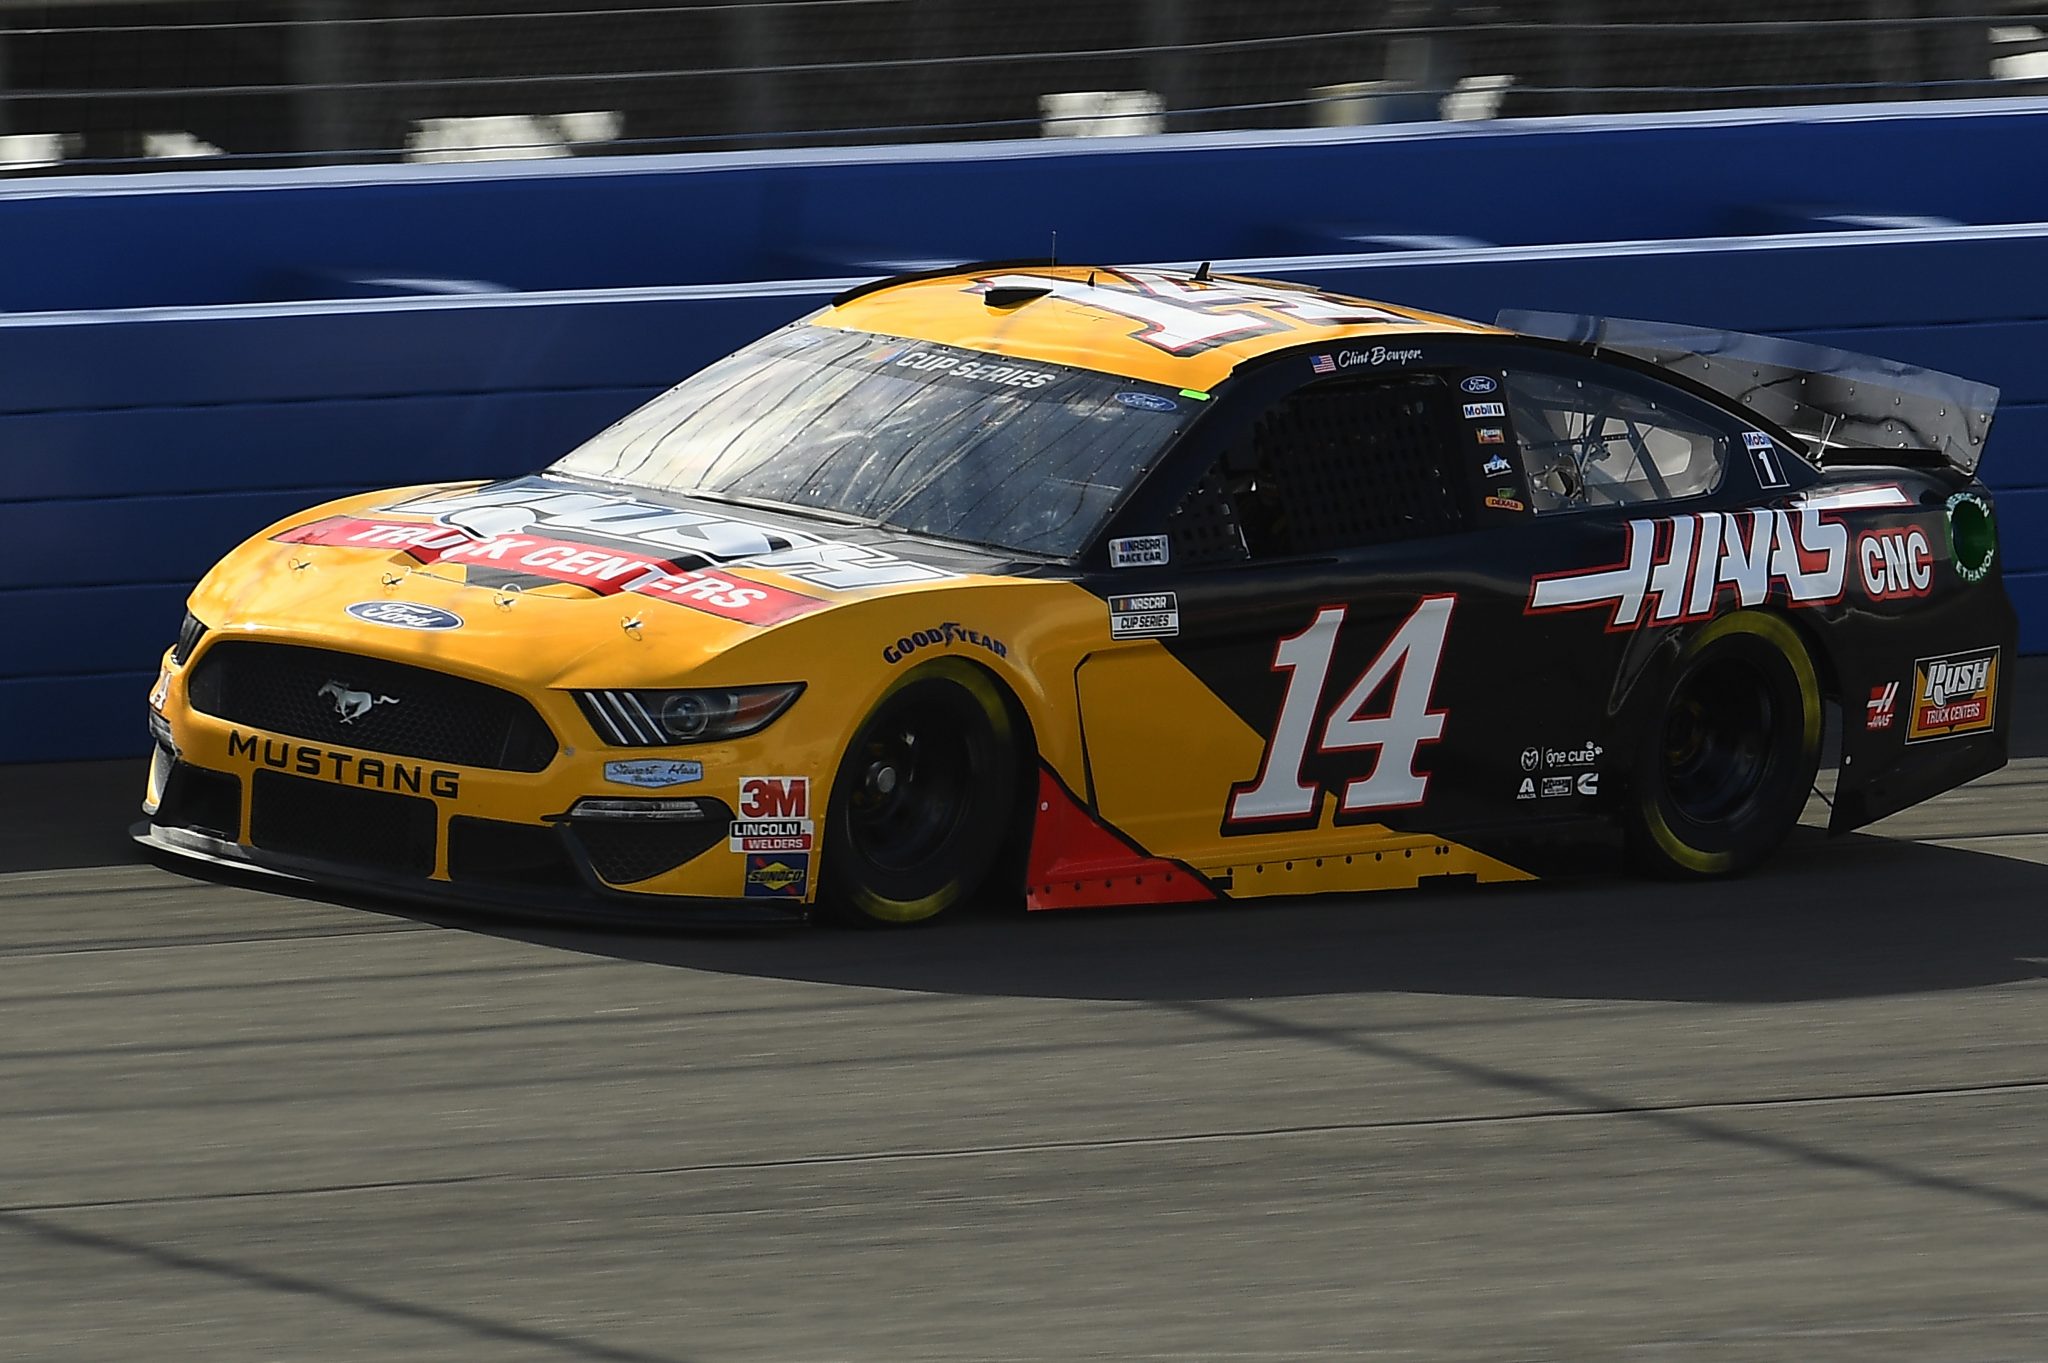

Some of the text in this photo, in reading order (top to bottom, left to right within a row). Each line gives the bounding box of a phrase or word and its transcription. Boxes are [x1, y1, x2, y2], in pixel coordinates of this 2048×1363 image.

[1338, 346, 1421, 368] Clint Bowyer
[896, 352, 1056, 389] CUP SERIES
[1469, 379, 1491, 391] Ford
[1465, 404, 1493, 416] Mobil
[1483, 458, 1511, 474] PEAK
[1758, 450, 1777, 483] 1
[1129, 539, 1160, 550] NASCAR
[1119, 551, 1162, 563] RACE CAR
[1861, 532, 1931, 594] CNC
[1956, 548, 1994, 582] ETHANOL
[519, 547, 768, 609] CENTERS
[1131, 597, 1166, 609] NASCAR
[363, 602, 442, 628] Ford
[1121, 615, 1169, 628] CUP SERIES
[883, 625, 1007, 664] GOODYEAR
[1923, 660, 1991, 707] RUSH
[1228, 592, 1458, 823] 14
[1926, 703, 1981, 725] TRUCK CENTERS
[228, 729, 460, 800] MUSTANG
[1568, 749, 1595, 762] cure
[741, 780, 806, 818] 3M
[734, 822, 799, 836] LINCOLN
[747, 837, 804, 850] WELDERS
[749, 870, 804, 883] SUNOCO
